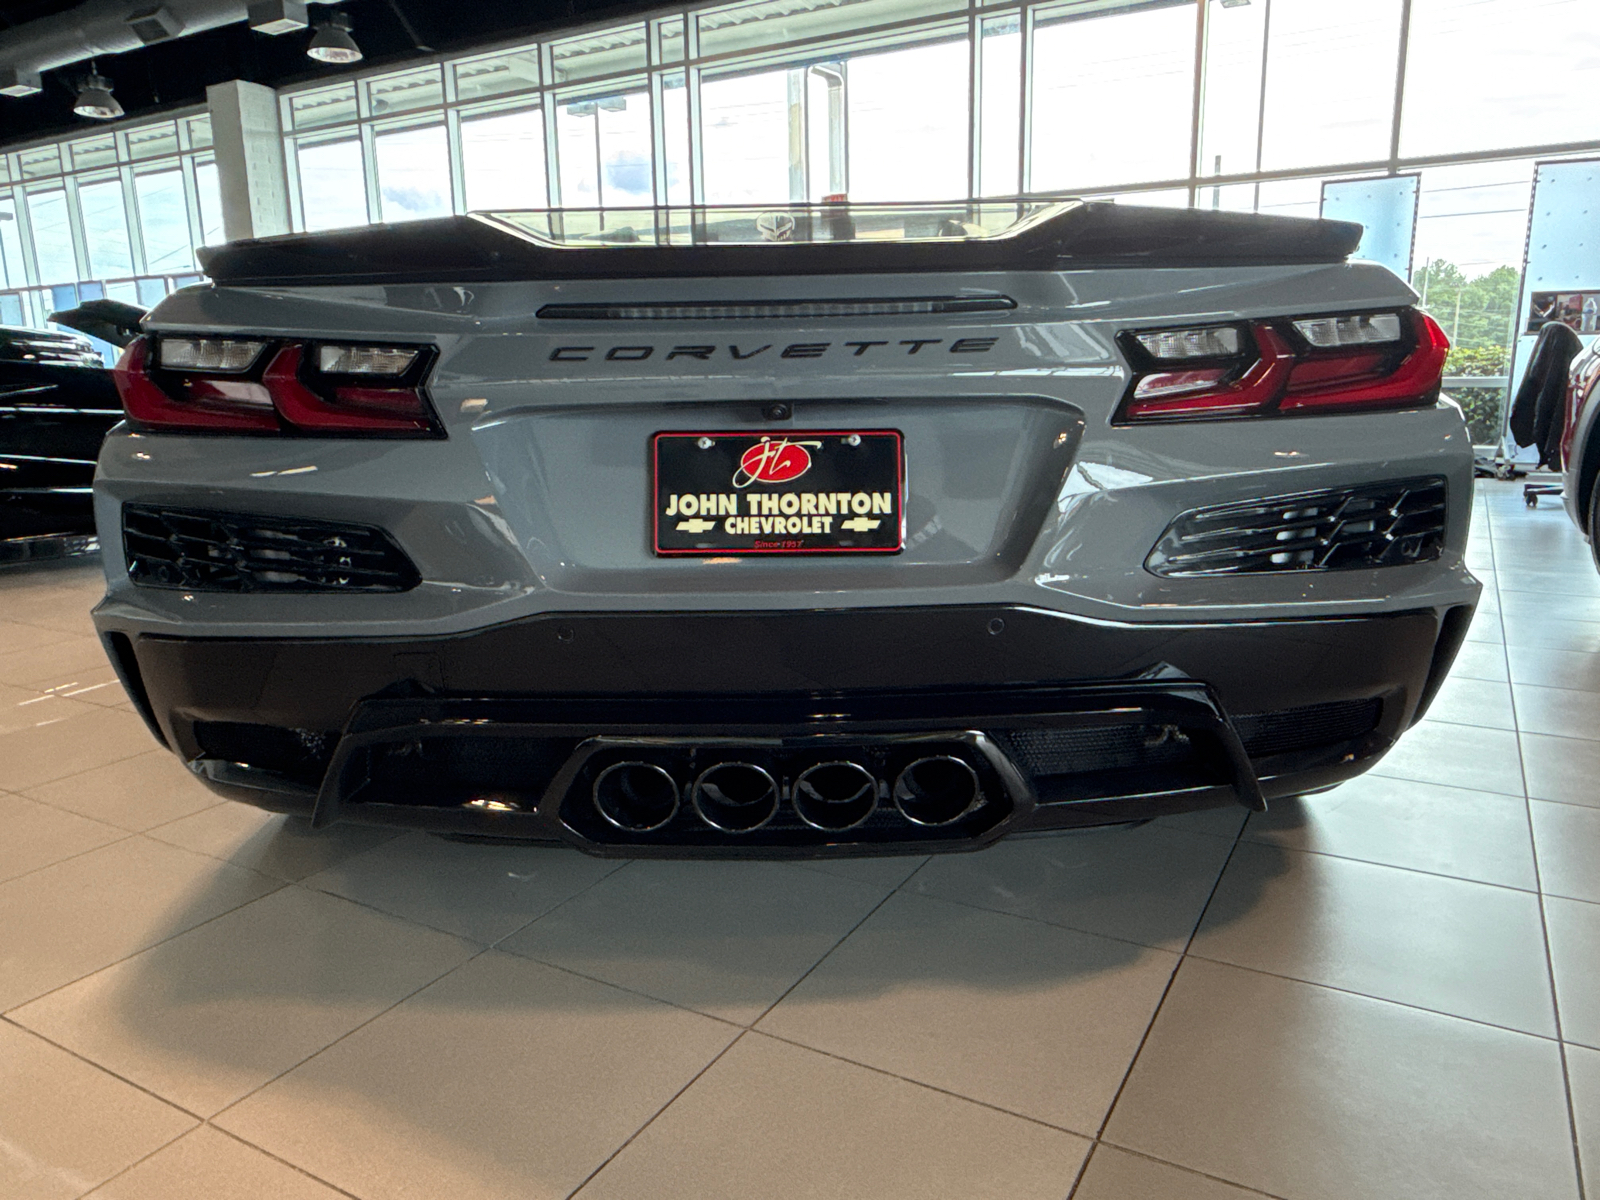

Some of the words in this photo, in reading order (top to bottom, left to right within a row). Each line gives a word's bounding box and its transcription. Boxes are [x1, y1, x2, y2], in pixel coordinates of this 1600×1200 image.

[549, 337, 999, 361] CORVETTE
[665, 494, 738, 516] JOHN
[747, 492, 892, 515] THORNTON
[724, 516, 833, 534] CHEVROLET
[754, 540, 779, 548] Since
[782, 540, 804, 548] 1957
